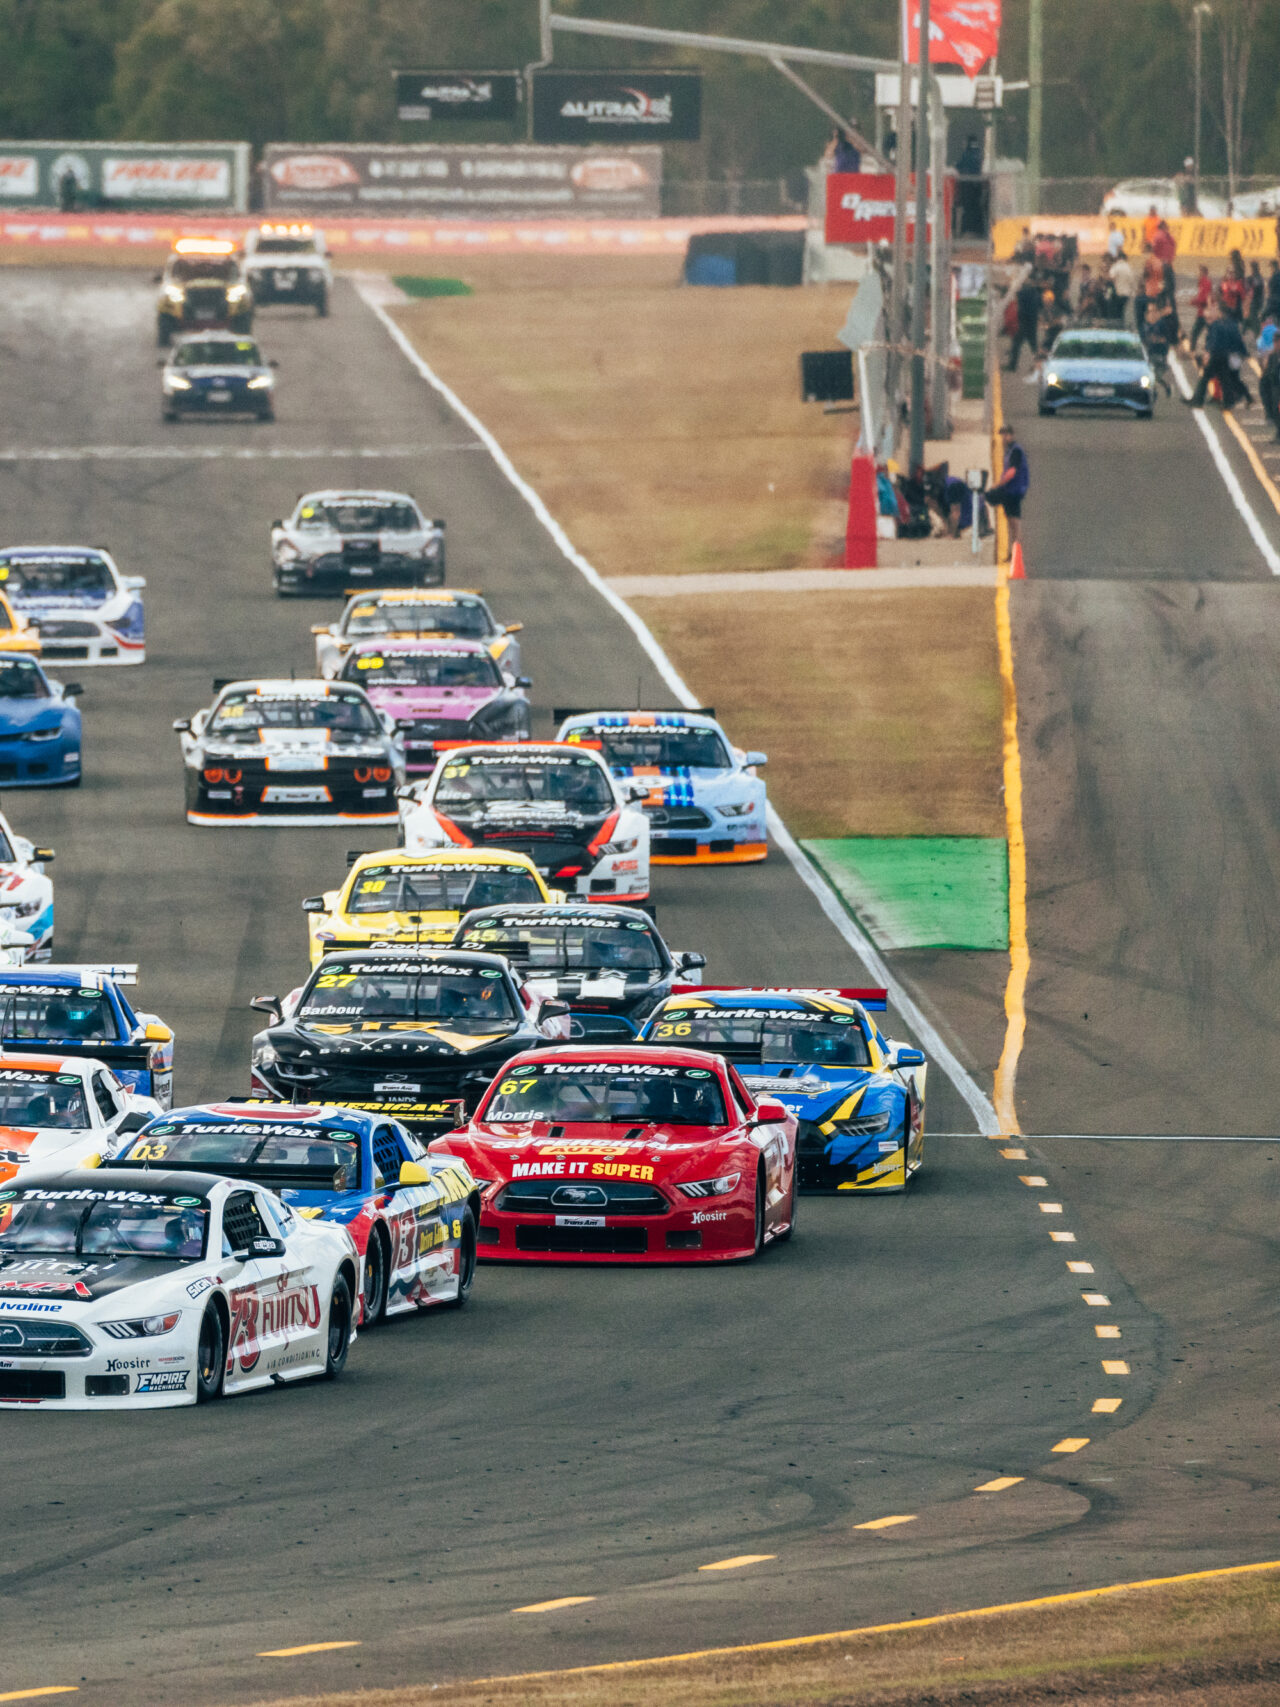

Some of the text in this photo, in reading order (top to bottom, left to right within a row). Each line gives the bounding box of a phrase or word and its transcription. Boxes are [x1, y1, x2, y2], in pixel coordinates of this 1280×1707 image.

[369, 941, 457, 951] Pioneer
[315, 975, 359, 988] 27
[300, 1004, 364, 1017] Barbour
[657, 1022, 693, 1038] 36
[498, 1079, 538, 1095] 67
[486, 1109, 545, 1122] Morris
[131, 1144, 168, 1160] 03
[548, 1145, 616, 1154] AUTO
[512, 1161, 655, 1181] MAKE IT SUPER
[104, 1356, 151, 1373] Hoosier
[136, 1371, 187, 1388] EMPIRE
